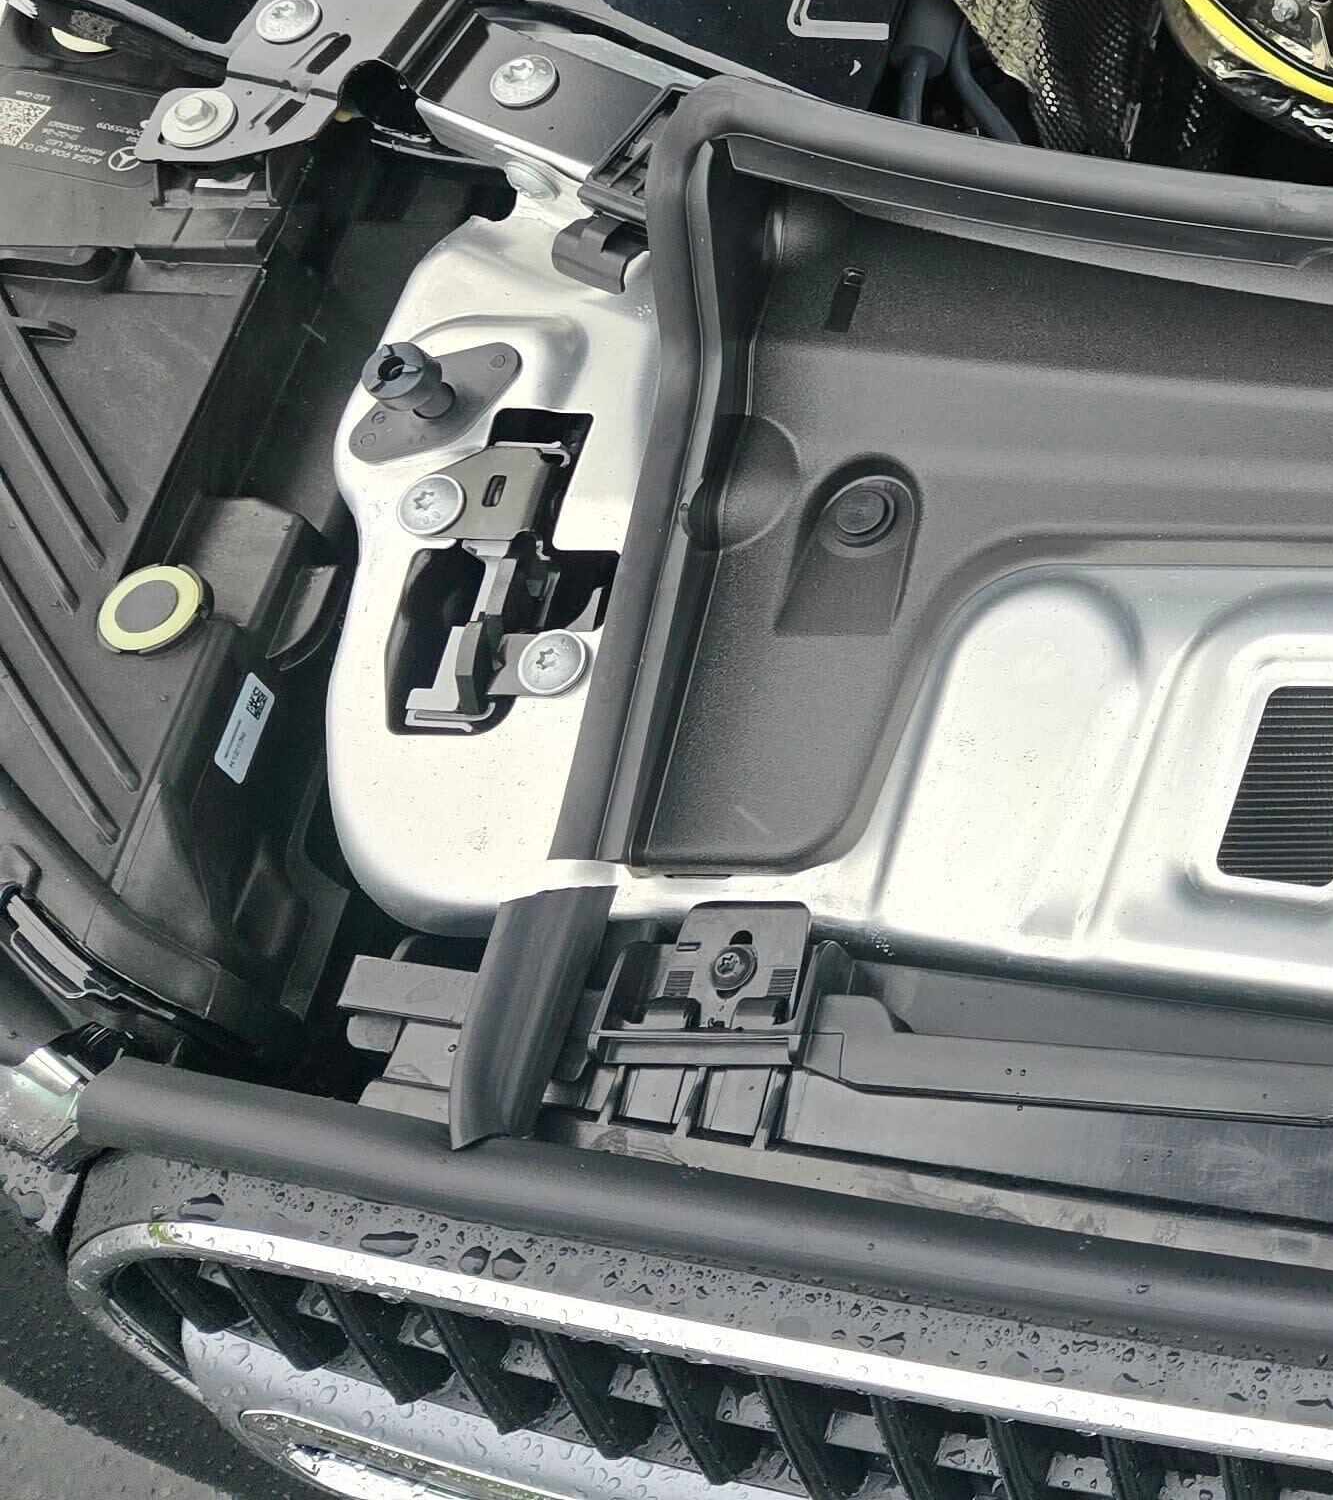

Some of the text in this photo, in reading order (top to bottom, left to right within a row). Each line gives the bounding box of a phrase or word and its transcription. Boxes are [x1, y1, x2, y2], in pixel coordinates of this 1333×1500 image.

[45, 138, 107, 157] RIGHT SAE LED
[71, 152, 103, 165] A254
